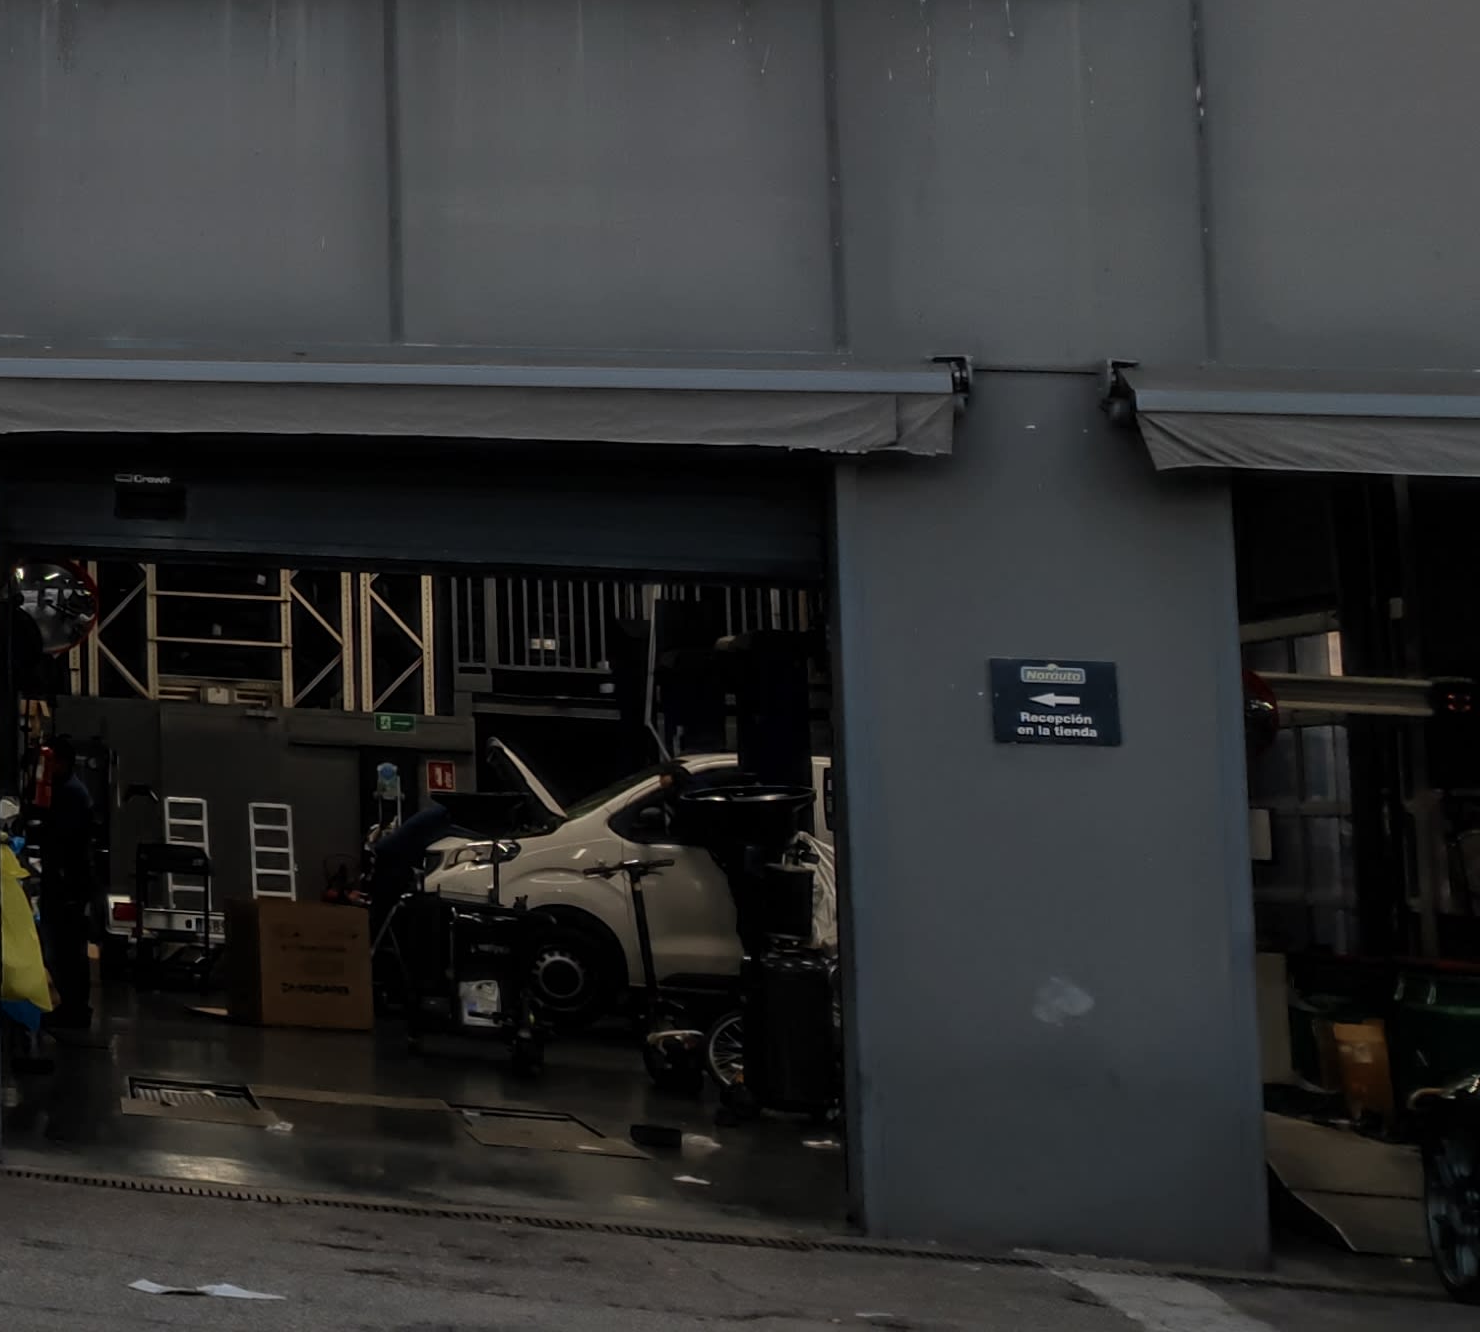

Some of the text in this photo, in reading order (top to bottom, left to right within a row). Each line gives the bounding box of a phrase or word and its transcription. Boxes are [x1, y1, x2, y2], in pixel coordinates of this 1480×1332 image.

[1026, 670, 1081, 681] Norauto
[1020, 712, 1092, 725] Recepción
[1017, 726, 1097, 738] en la tienda
